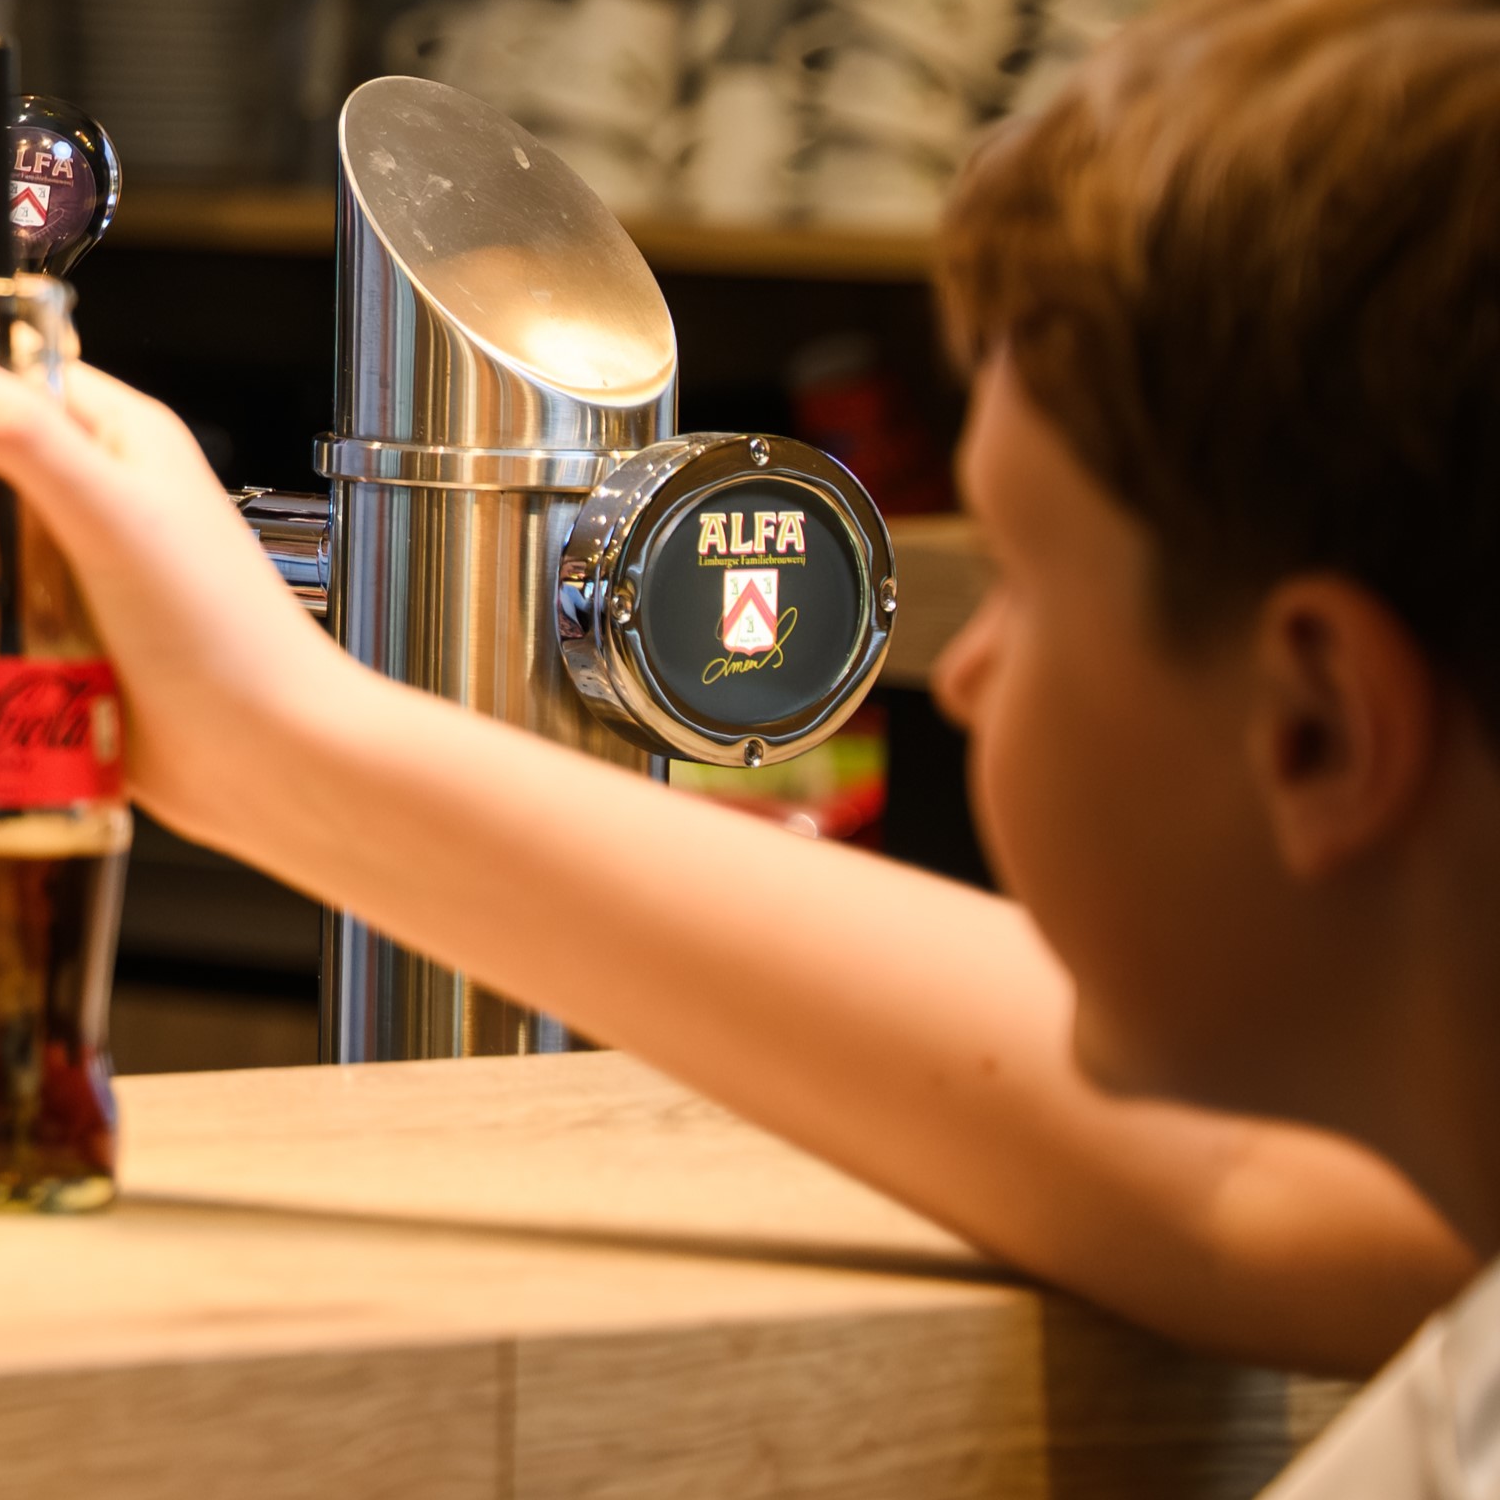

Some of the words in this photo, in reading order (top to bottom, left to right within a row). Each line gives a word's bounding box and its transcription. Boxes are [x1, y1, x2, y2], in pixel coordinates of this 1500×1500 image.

[12, 149, 74, 179] LFA
[698, 511, 806, 555] ALFA
[698, 554, 740, 568] Limburgse
[740, 553, 807, 568] Familiebrouwerij
